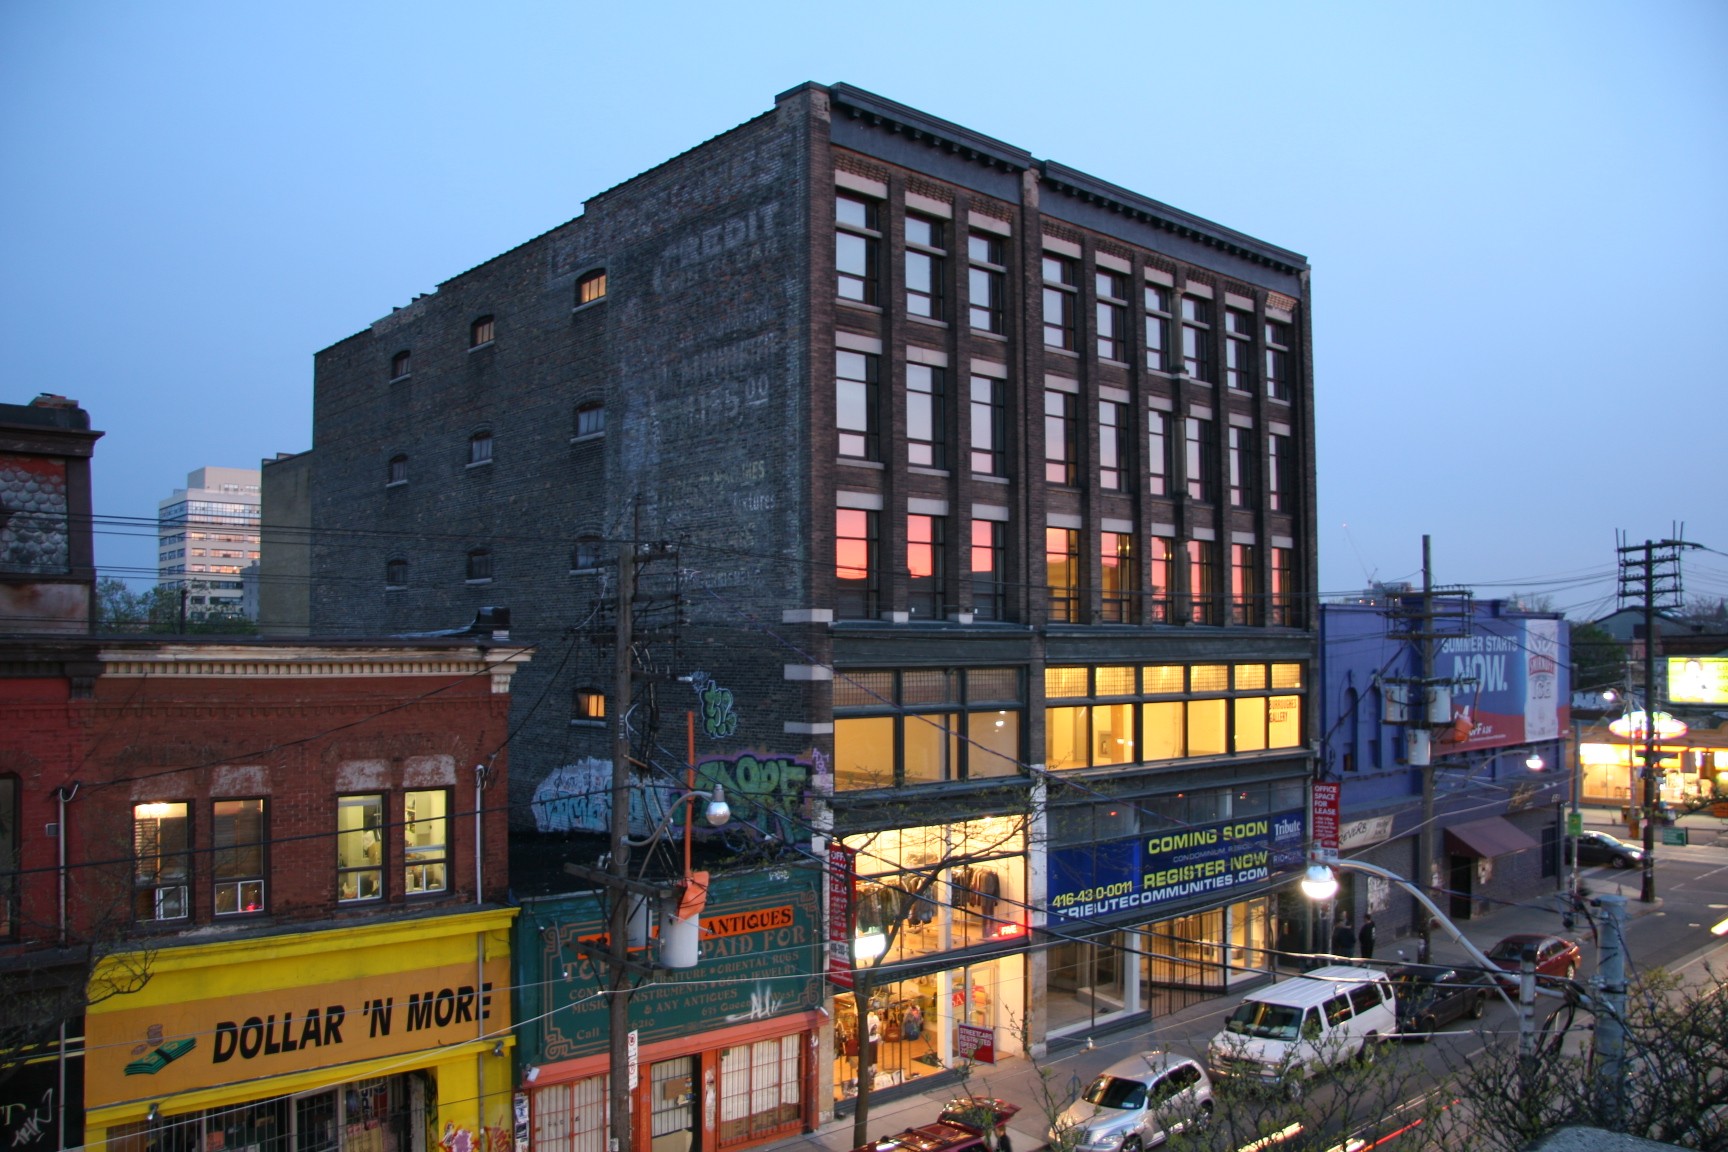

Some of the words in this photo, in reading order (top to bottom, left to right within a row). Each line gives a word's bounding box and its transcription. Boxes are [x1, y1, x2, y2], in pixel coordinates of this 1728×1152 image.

[1442, 637, 1484, 653] SUMMER
[1485, 635, 1518, 652] STARTS
[1453, 654, 1508, 696] NOW.
[1315, 785, 1337, 793] OFFICE
[1149, 829, 1218, 854] COMING
[1223, 820, 1268, 840] SOON
[1274, 819, 1302, 836] Tribute
[1144, 859, 1225, 889] REGISTER
[1231, 851, 1268, 871] NOW
[705, 908, 792, 937] ANTIQUES
[702, 934, 754, 960] PAID
[763, 925, 806, 951] FOR
[717, 957, 768, 974] ORIENTAL
[773, 951, 799, 963] RUGS
[655, 998, 678, 1012] ANY
[684, 988, 738, 1006] ANTIQUES
[212, 1004, 345, 1064] DOLLAR
[363, 997, 393, 1038] 'N
[406, 982, 493, 1032] MORE
[576, 1027, 600, 1040] Call
[960, 1034, 991, 1046] RESTRITED
